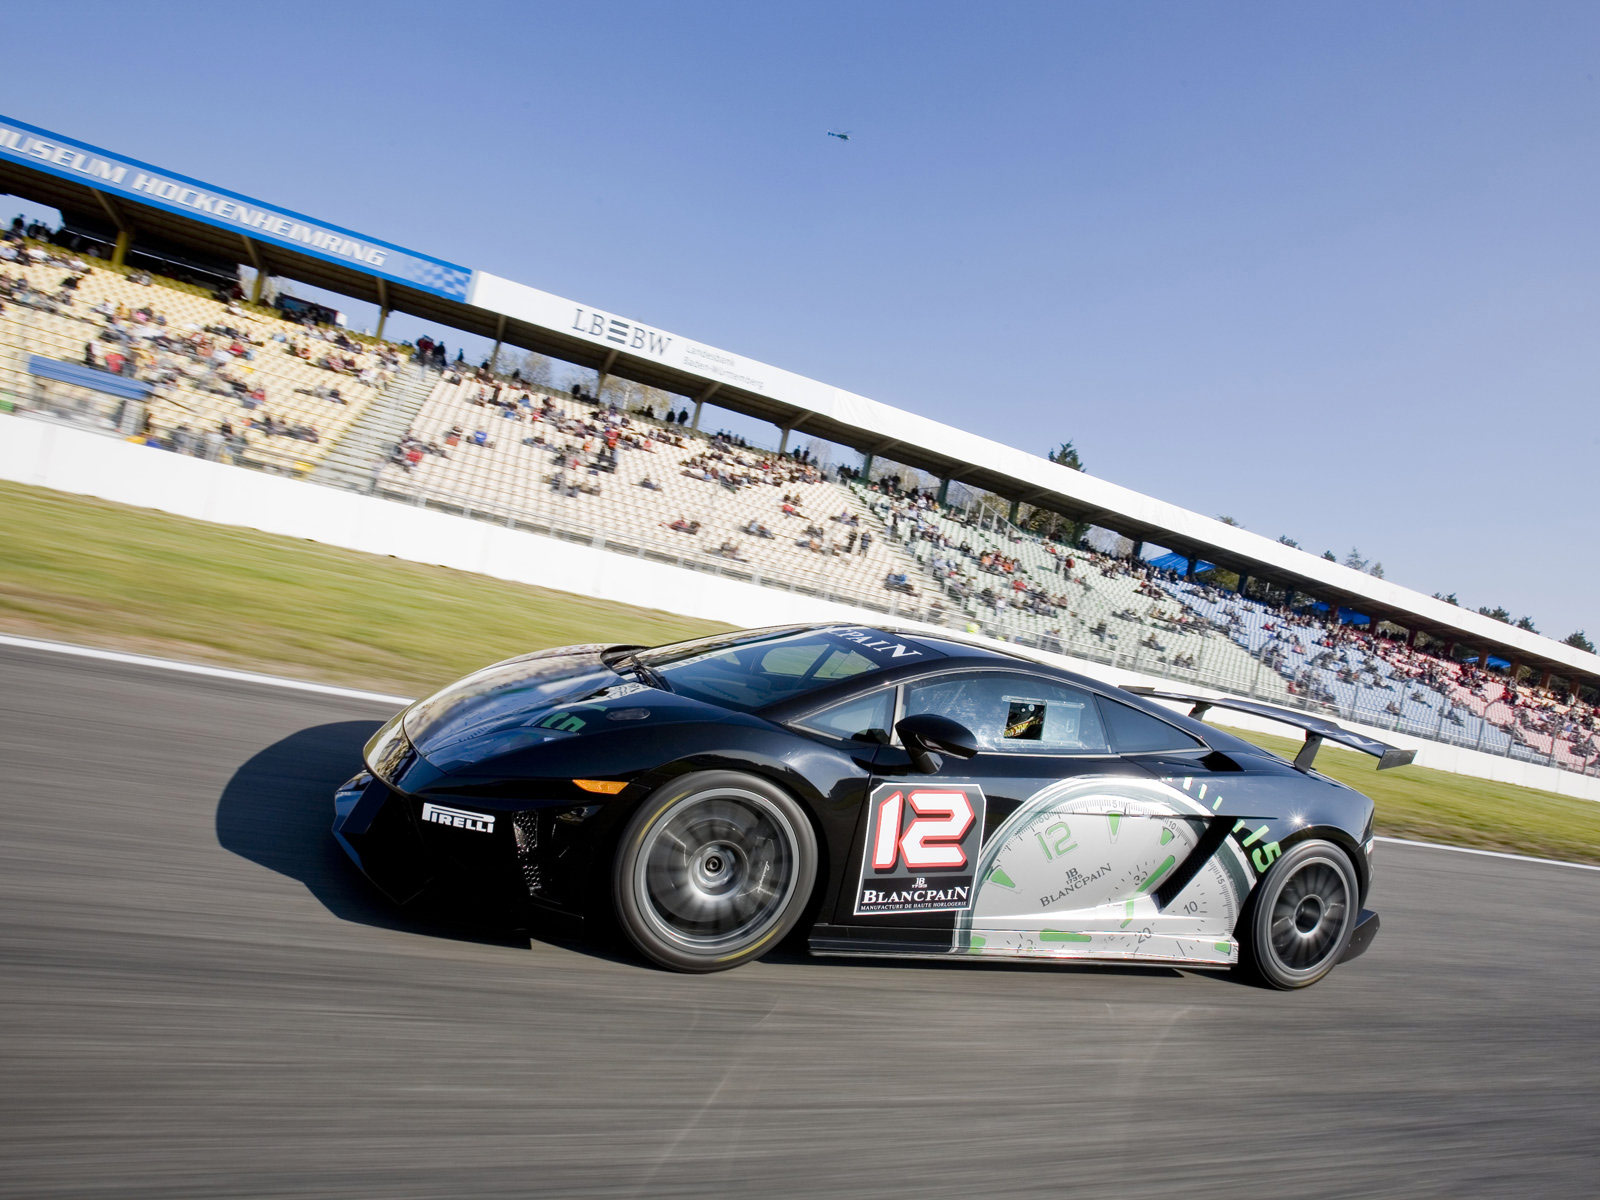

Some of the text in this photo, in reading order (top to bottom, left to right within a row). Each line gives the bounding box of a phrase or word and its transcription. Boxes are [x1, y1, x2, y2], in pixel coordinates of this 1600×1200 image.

[131, 165, 389, 267] HOCKENHEIMRING
[421, 802, 496, 834] PIRELLI
[872, 790, 975, 870] 12
[1034, 821, 1079, 862] 12
[862, 886, 970, 904] BLANCPAIN
[1040, 863, 1112, 907] BLANCPAIN
[861, 903, 903, 911] MANUFACTURE
[1183, 901, 1199, 915] 10
